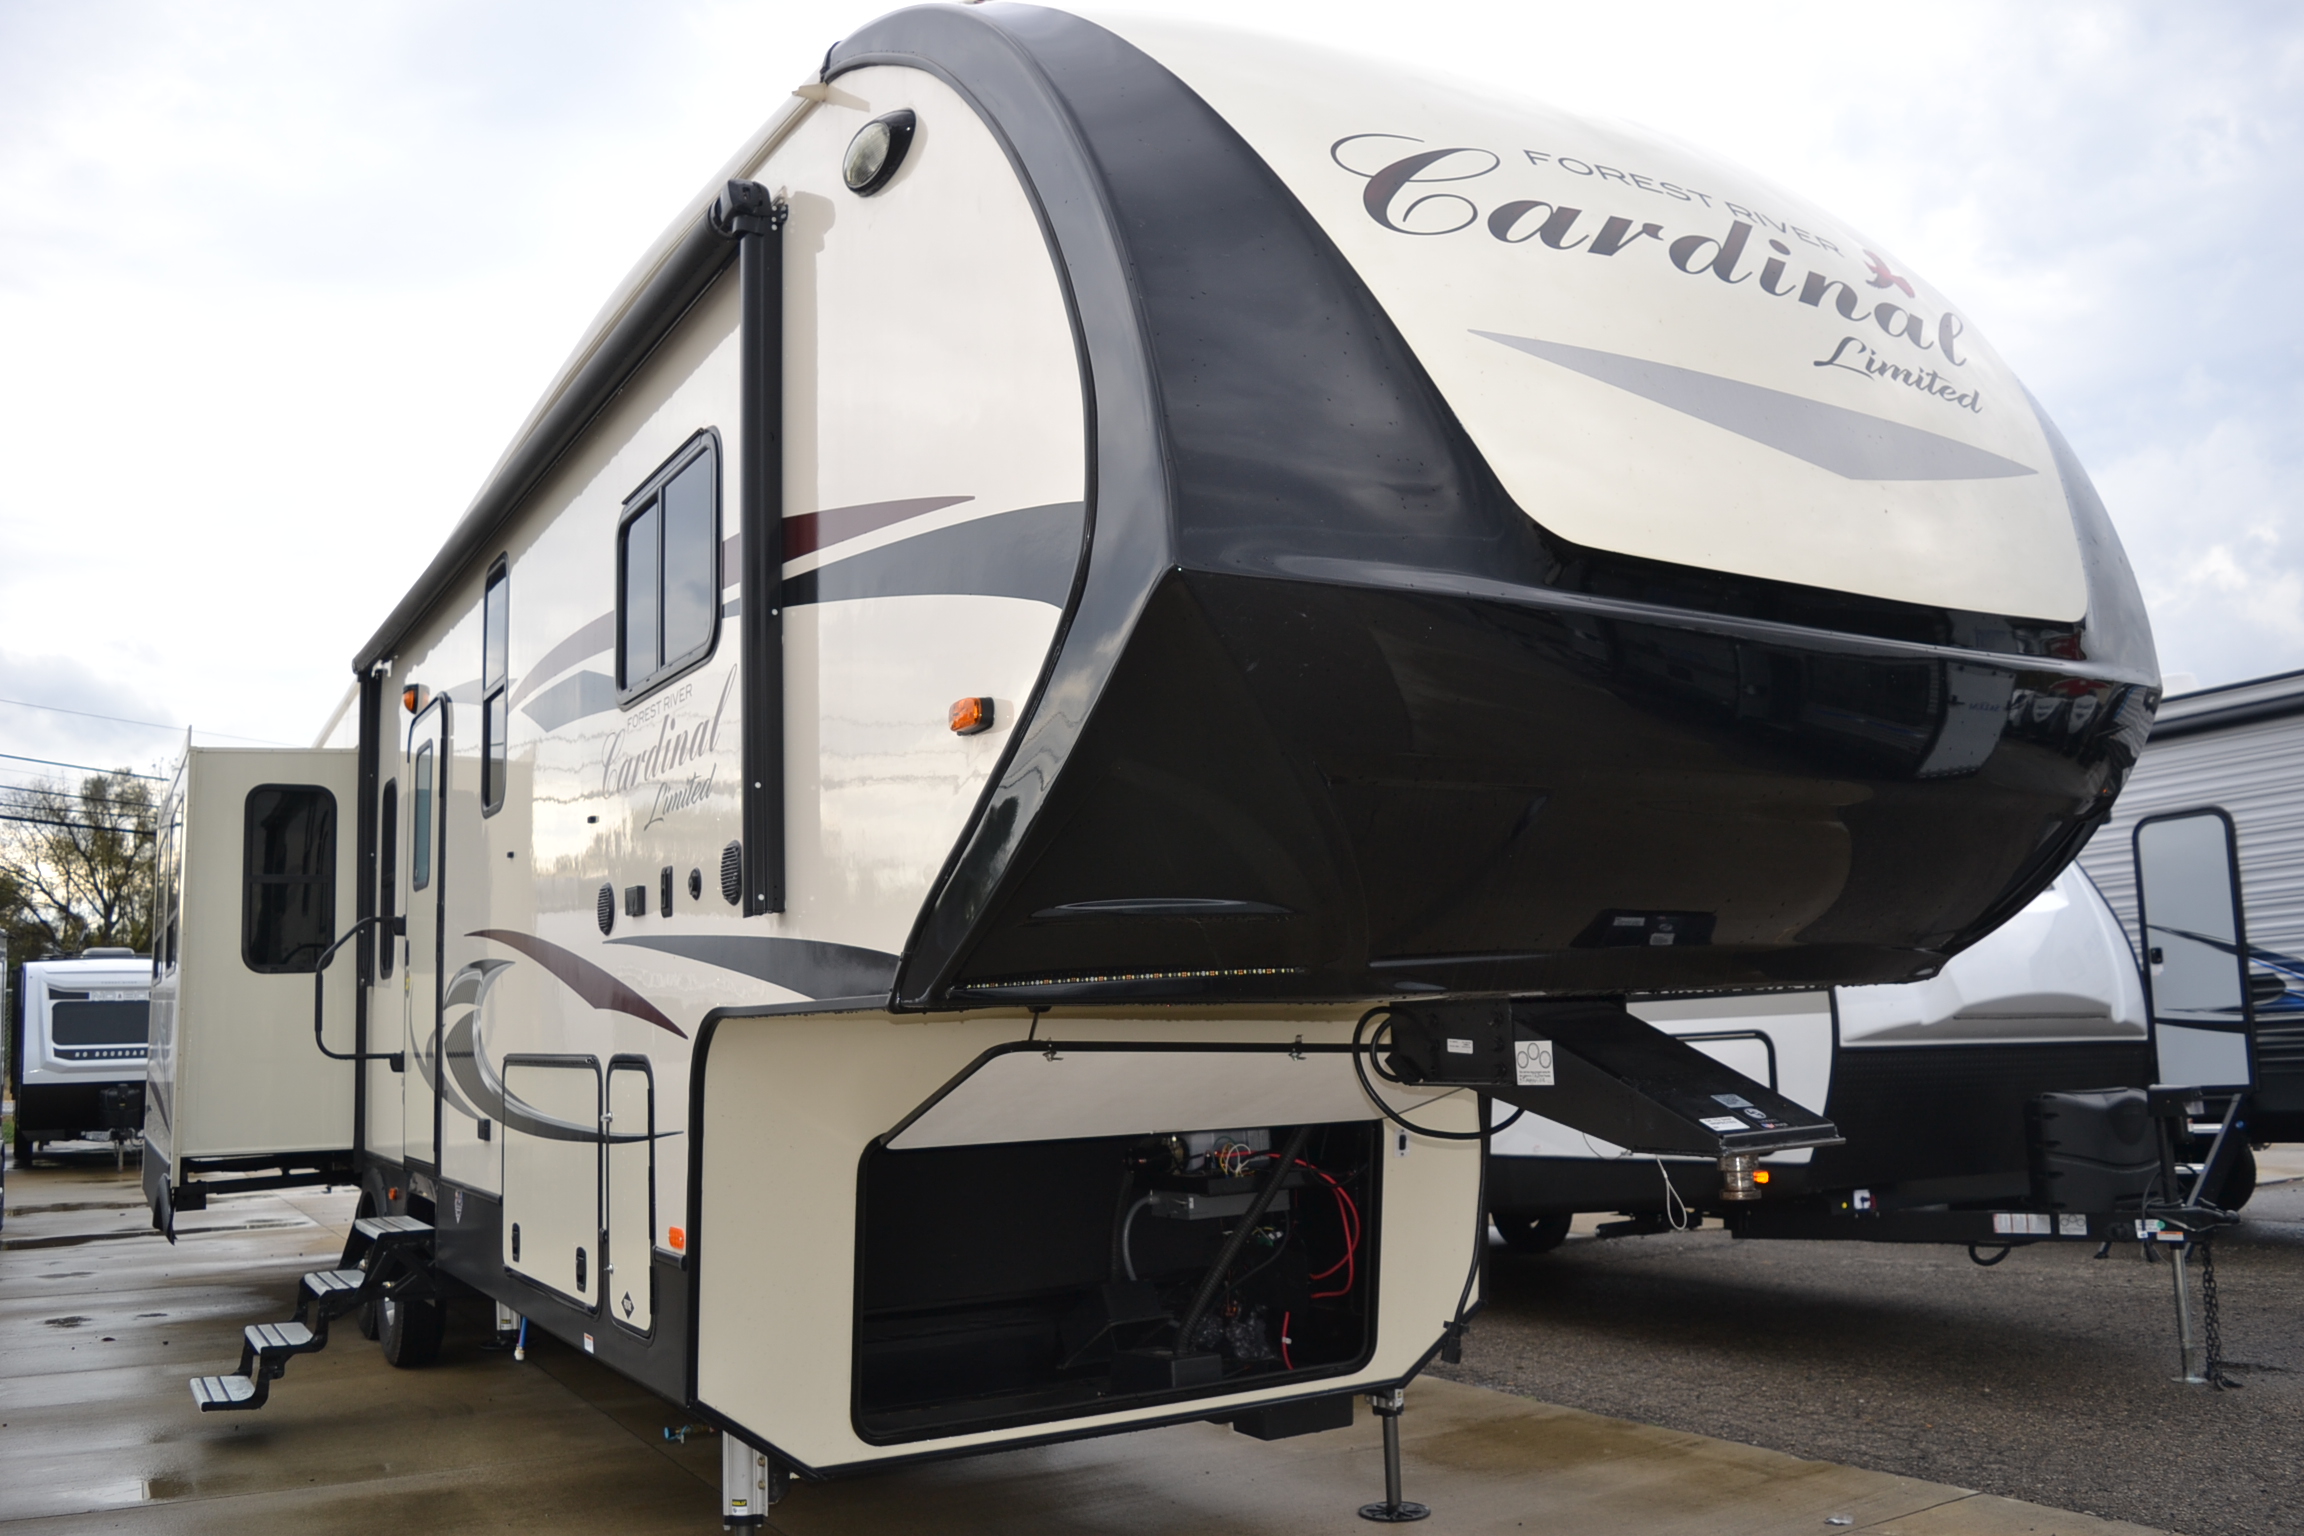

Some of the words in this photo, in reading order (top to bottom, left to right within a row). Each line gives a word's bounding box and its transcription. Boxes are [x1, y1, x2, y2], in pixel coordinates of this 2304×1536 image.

[1330, 133, 1968, 367] Cardinal
[1523, 149, 1713, 208] FOREST
[1724, 201, 1845, 258] RIVER
[1813, 336, 1983, 414] Limited
[602, 663, 738, 799] Cardinal
[627, 701, 662, 731] FOREST
[664, 683, 693, 710] RIVER
[644, 762, 717, 832] Limited
